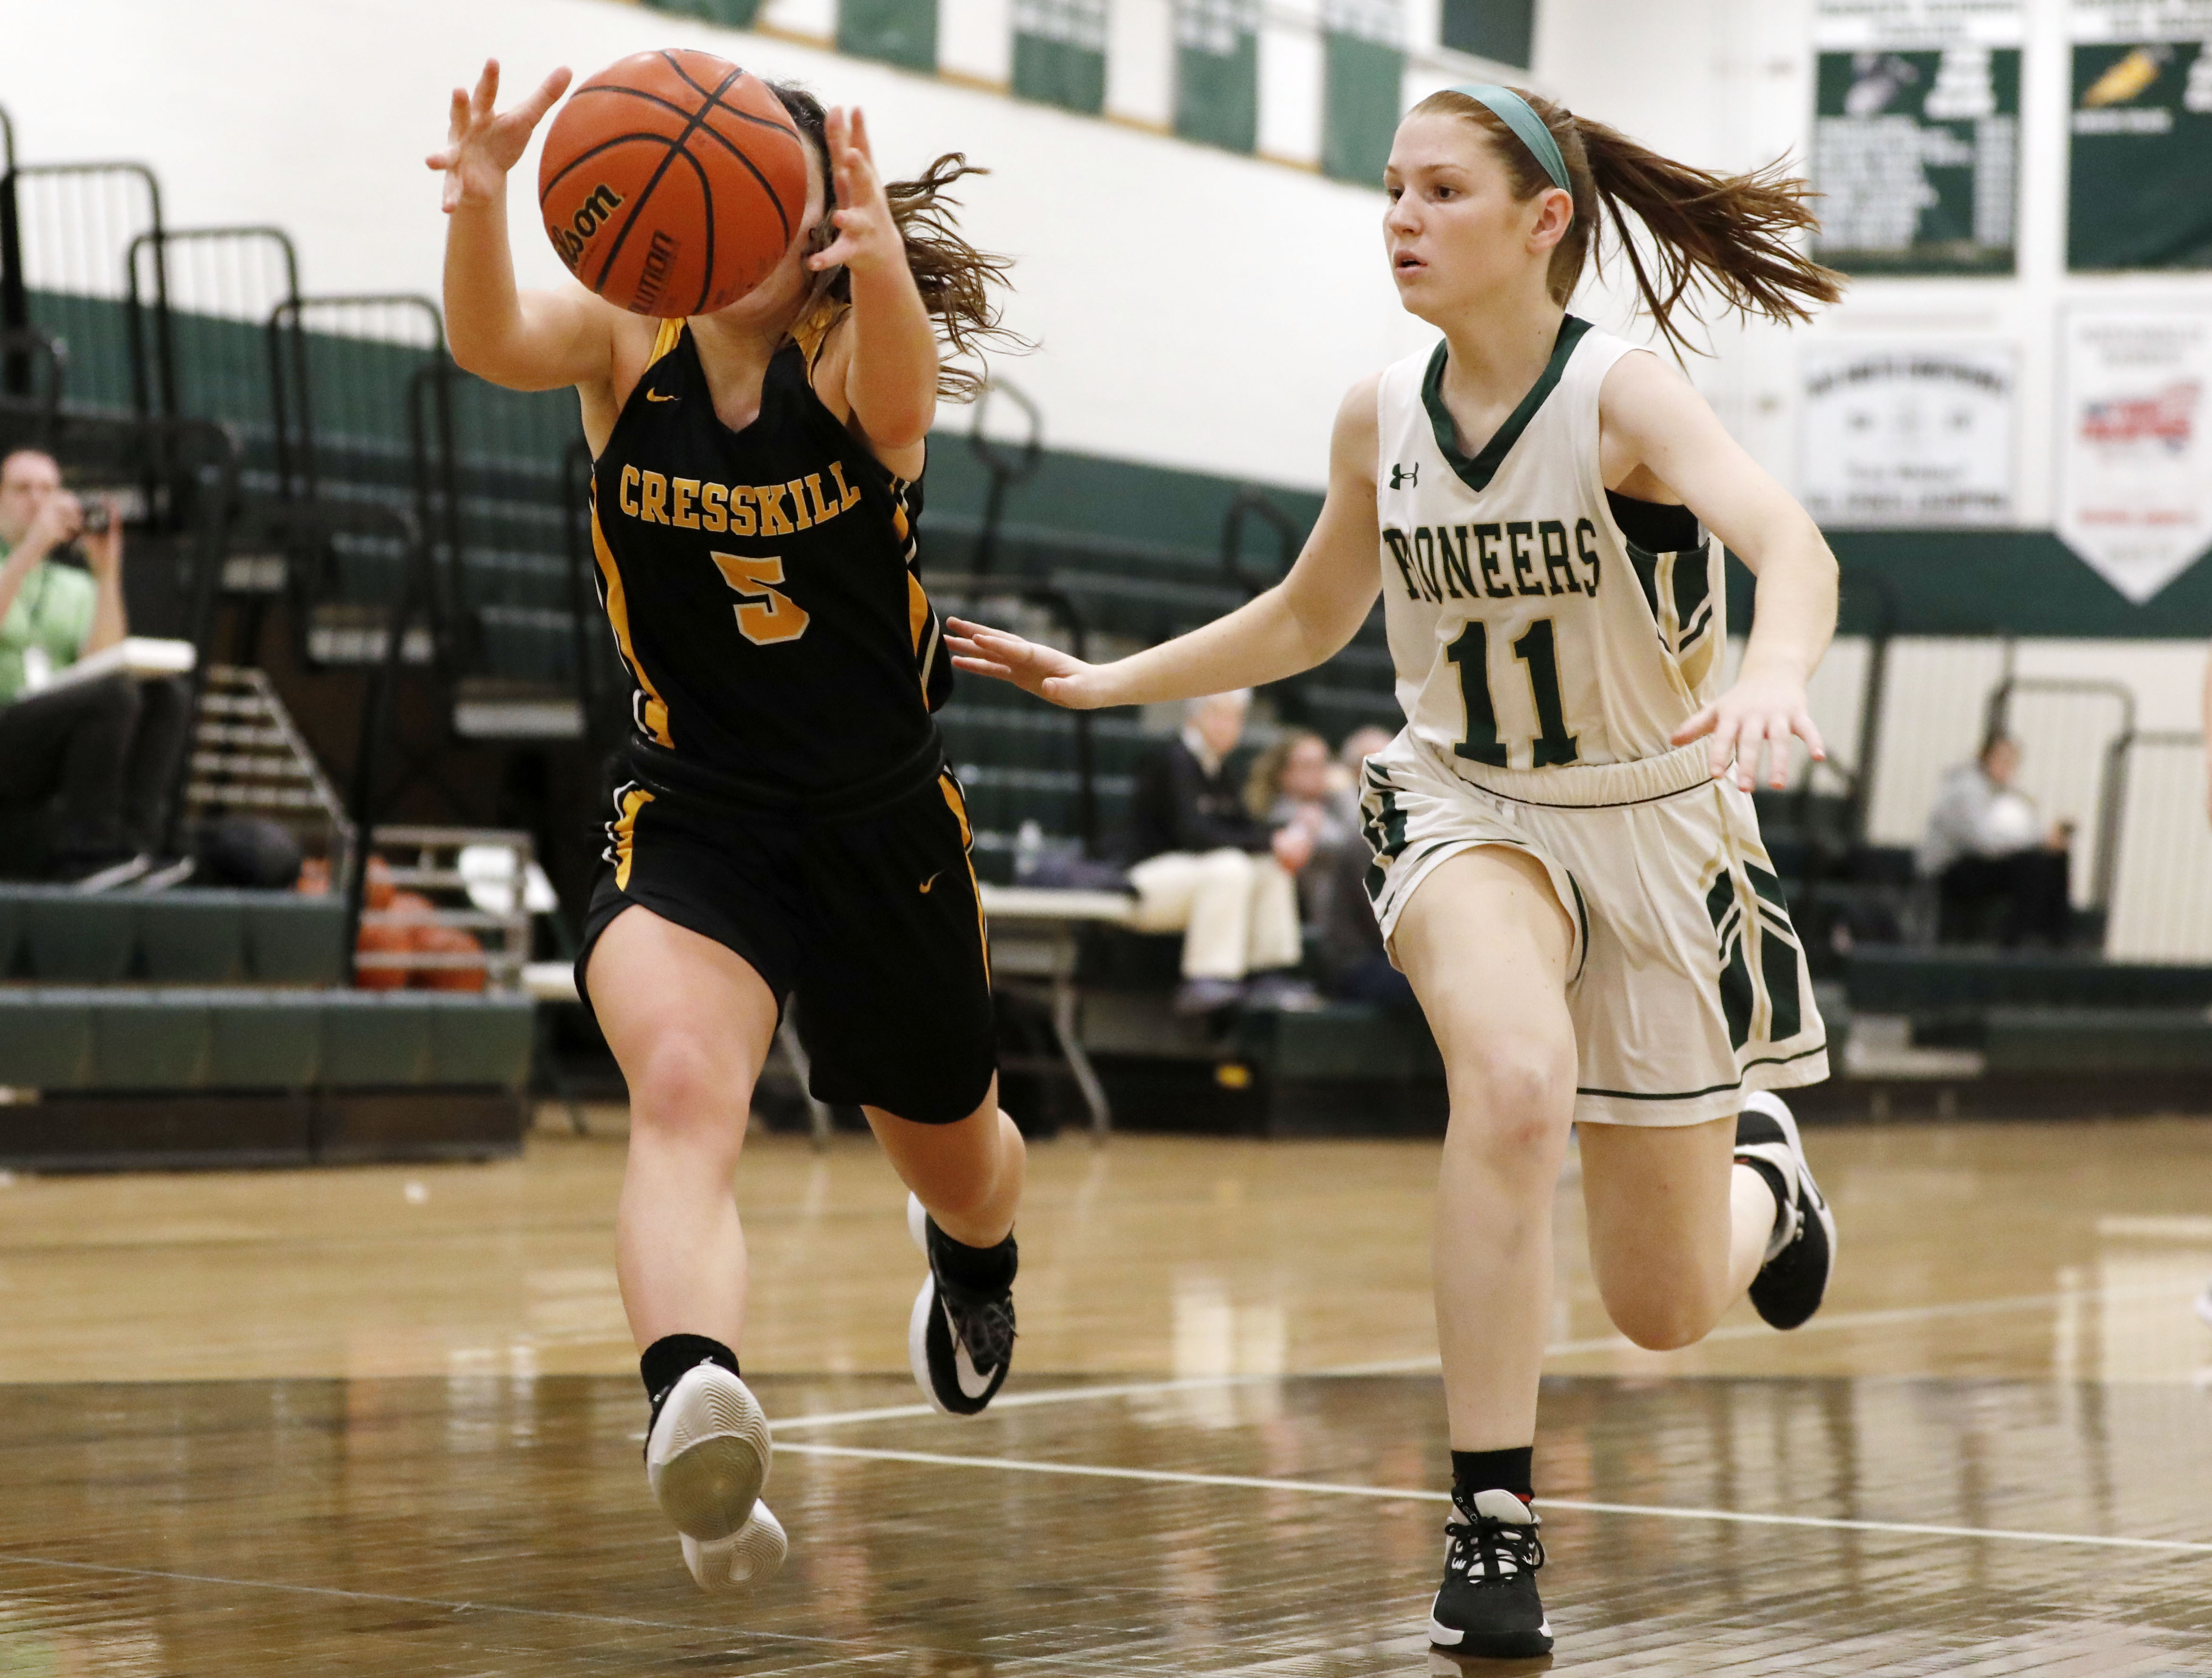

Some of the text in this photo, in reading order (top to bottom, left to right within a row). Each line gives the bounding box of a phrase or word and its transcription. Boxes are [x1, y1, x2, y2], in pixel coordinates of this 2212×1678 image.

[550, 183, 624, 271] lson
[619, 461, 861, 537] CRESSKILL
[710, 550, 810, 646] 5
[1444, 617, 1582, 769] 11
